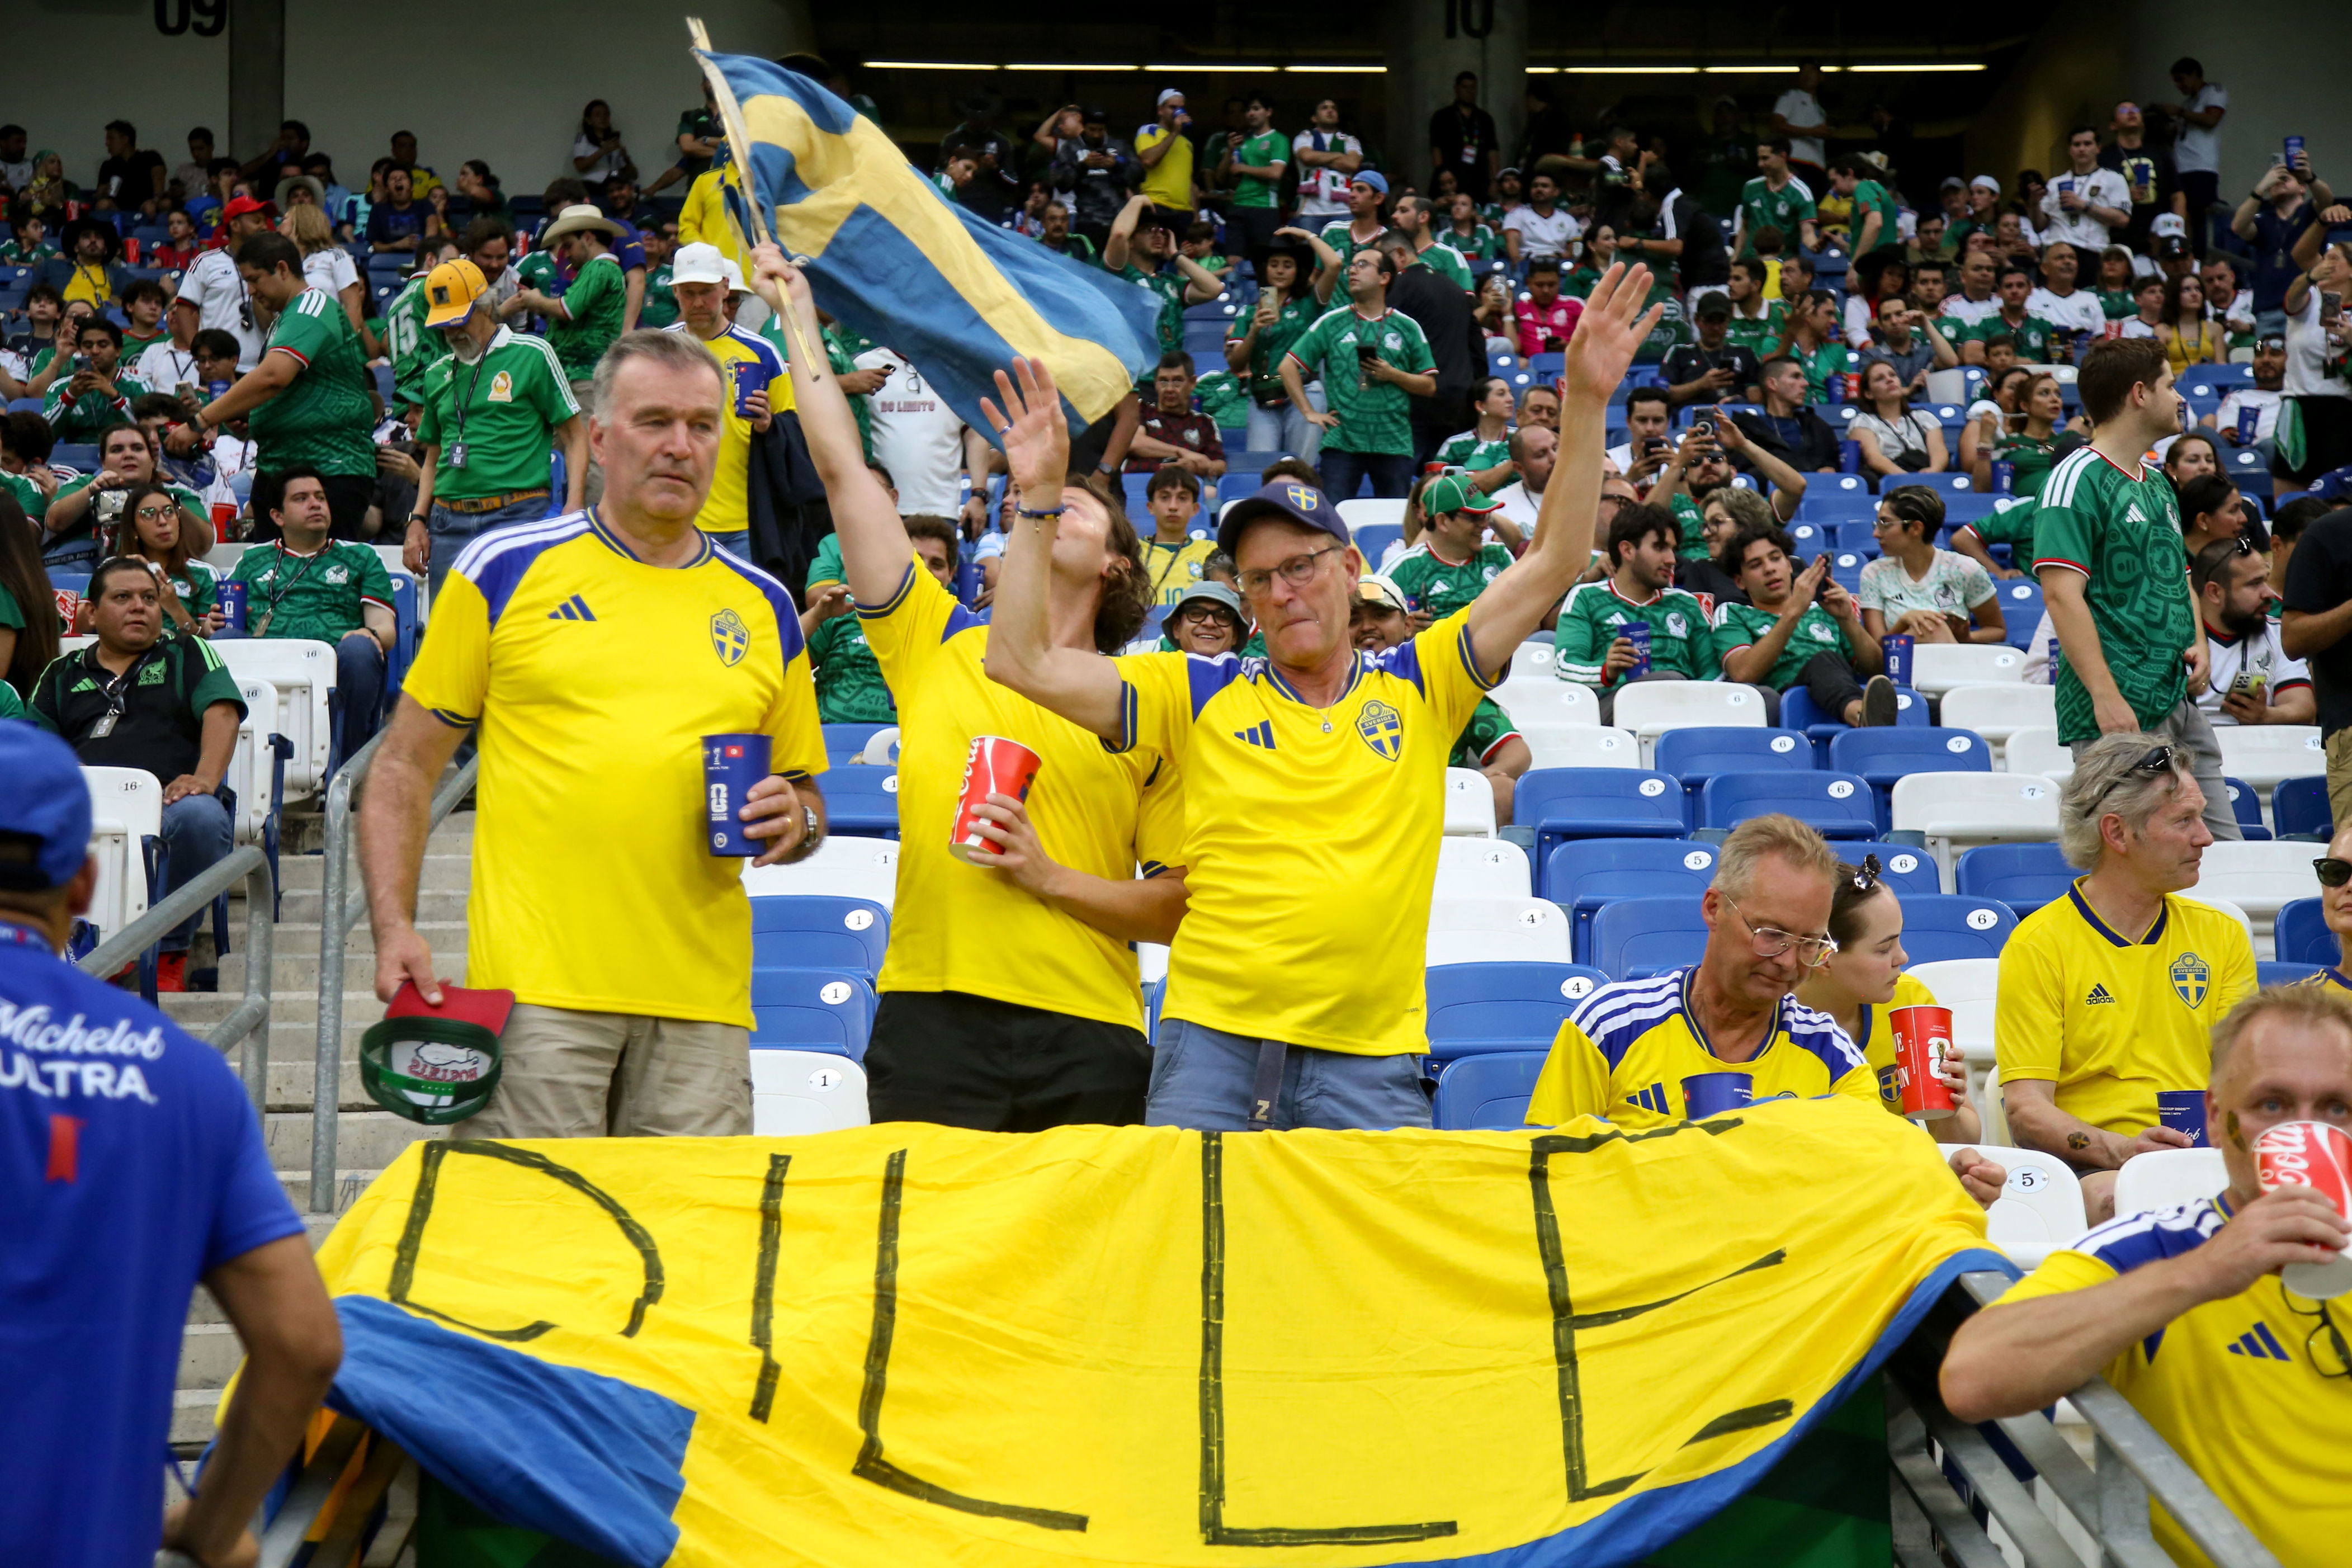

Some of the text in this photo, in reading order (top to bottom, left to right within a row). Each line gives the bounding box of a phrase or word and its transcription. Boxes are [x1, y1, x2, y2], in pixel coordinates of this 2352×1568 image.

[386, 300, 419, 364] 15
[717, 621, 743, 636] SVERIGE
[247, 689, 257, 698] 16
[1364, 715, 1393, 727] SVERIGE
[124, 781, 137, 791] 16
[884, 855, 887, 863] 1
[1694, 856, 1702, 865] 5
[857, 916, 861, 924] 1
[1528, 914, 1534, 923] 4
[1978, 915, 1986, 924] 6
[1572, 983, 1581, 993] 4
[834, 989, 838, 998] 1
[2086, 996, 2115, 1005] adidas
[0, 1049, 158, 1104] ULTRA
[821, 1075, 828, 1086] 1
[2022, 1173, 2034, 1186] 5
